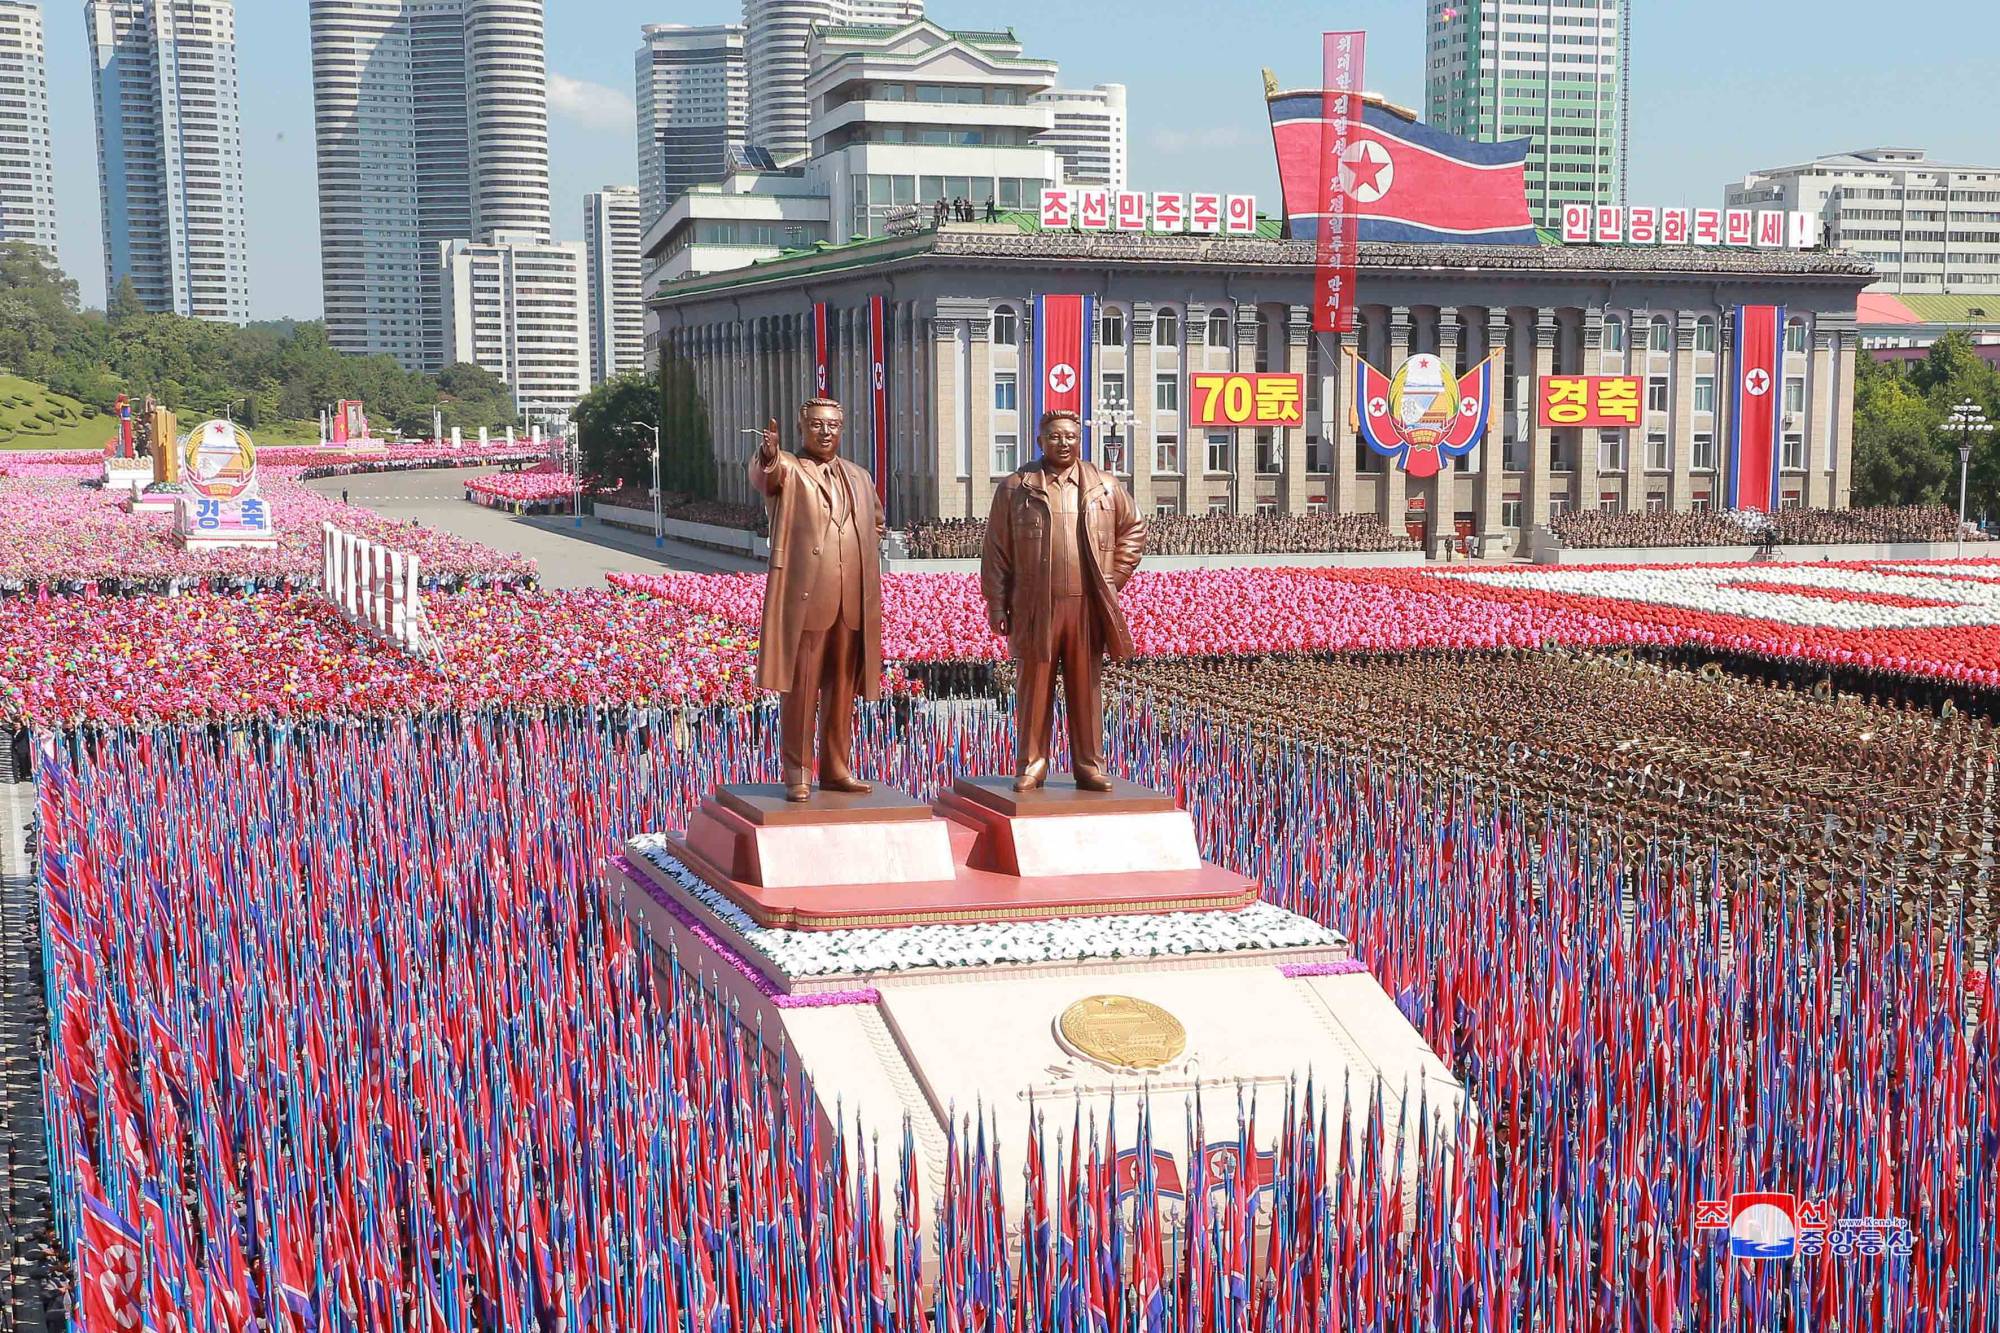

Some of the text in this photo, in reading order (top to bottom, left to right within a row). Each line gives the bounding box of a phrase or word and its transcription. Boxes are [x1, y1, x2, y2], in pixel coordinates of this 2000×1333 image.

[1336, 34, 1352, 89] 위대한
[1044, 192, 1253, 231] 조선민주주의
[1326, 275, 1342, 328] 만세!
[1195, 376, 1300, 423] 70돐
[1547, 377, 1639, 423] 경축
